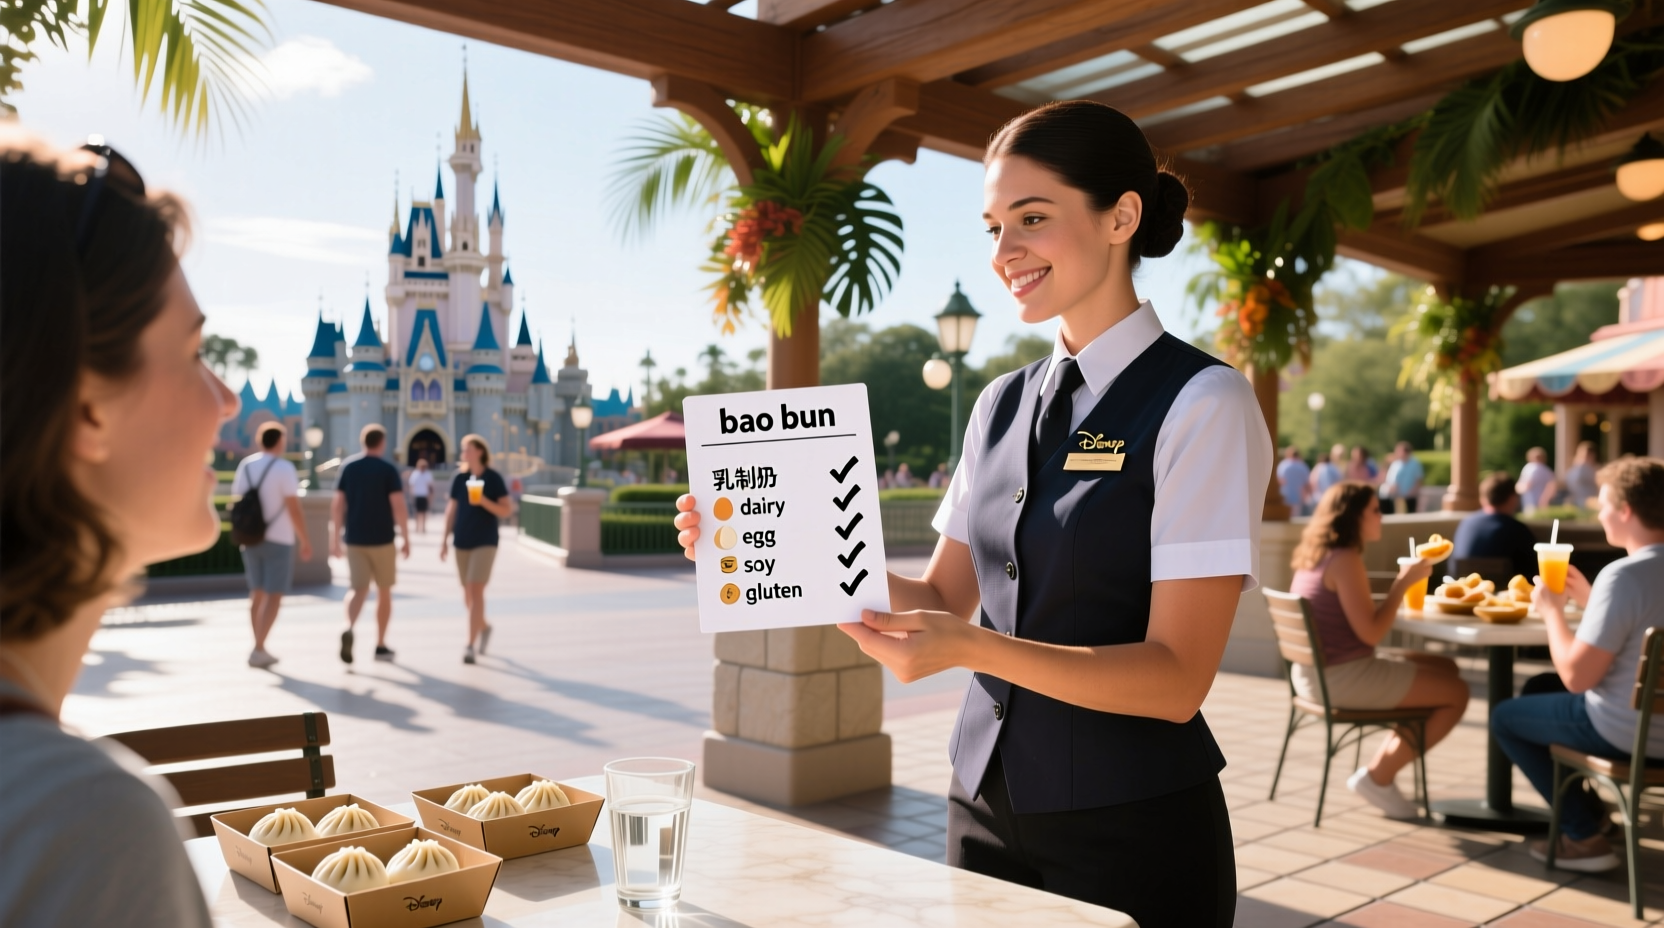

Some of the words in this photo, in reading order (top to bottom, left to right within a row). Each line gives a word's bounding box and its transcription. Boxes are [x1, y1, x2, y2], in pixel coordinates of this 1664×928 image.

[719, 407, 774, 434] bao
[780, 403, 836, 430] bun
[740, 497, 786, 518] dairy
[742, 529, 777, 548] egg
[744, 558, 776, 576] soy
[745, 582, 803, 605] gluten
